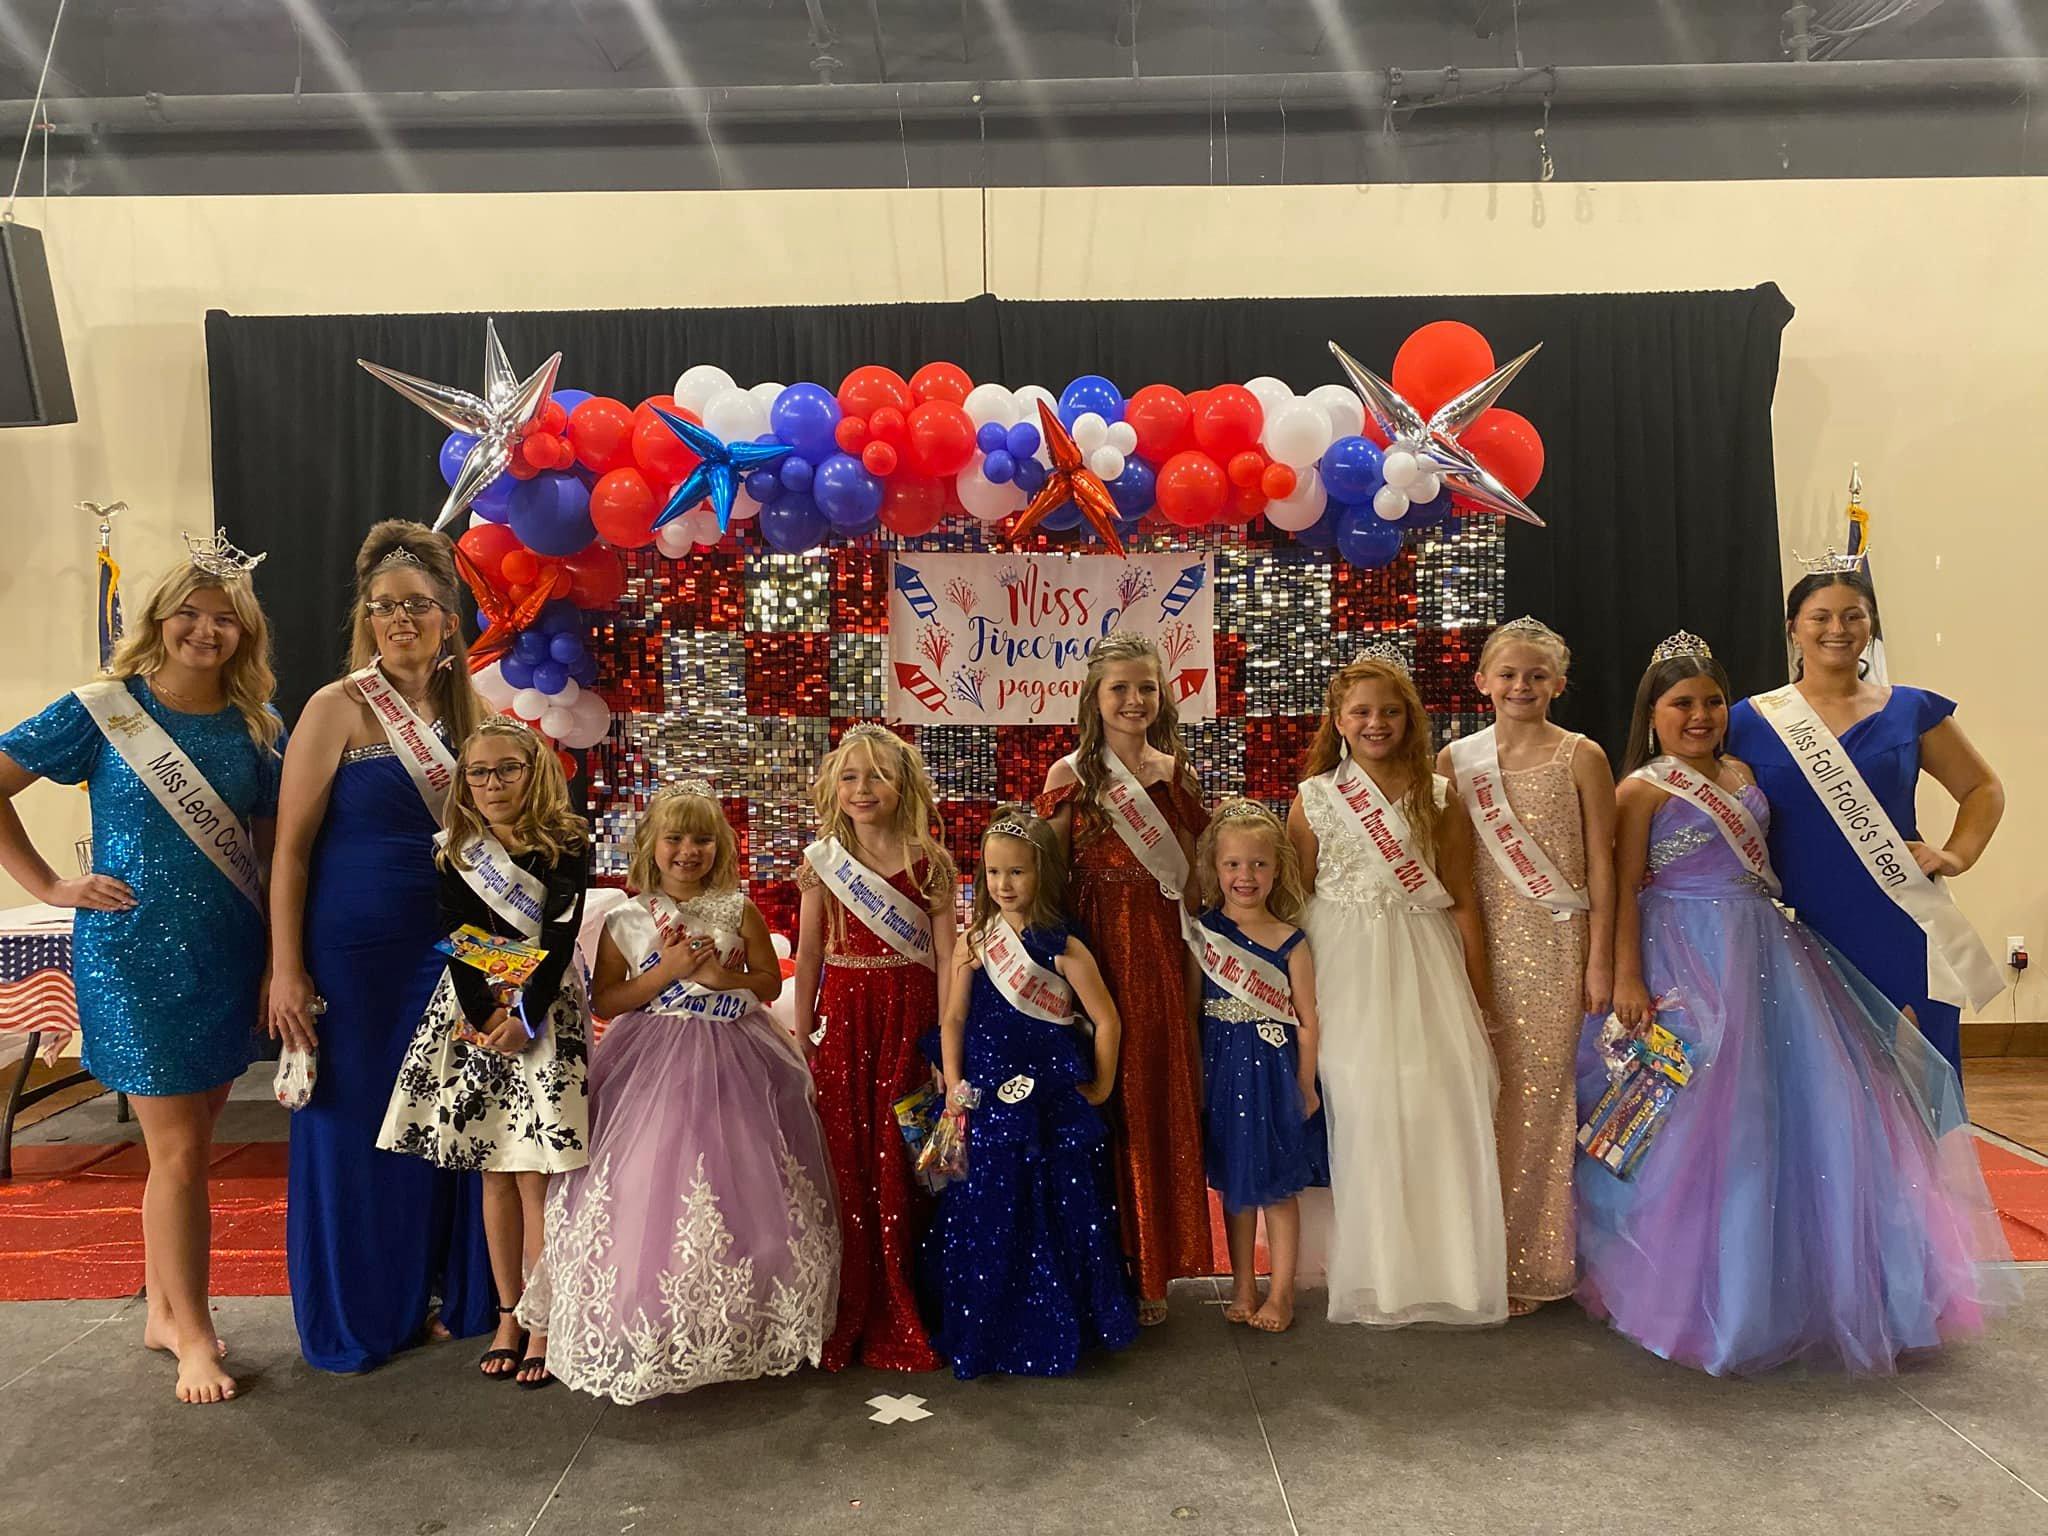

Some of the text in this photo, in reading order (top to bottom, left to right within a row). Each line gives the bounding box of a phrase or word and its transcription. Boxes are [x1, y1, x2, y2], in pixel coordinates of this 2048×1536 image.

[1006, 562, 1097, 627] Miss
[998, 677, 1084, 714] pagean
[372, 691, 407, 724] Amazing
[398, 720, 433, 764] Firecracker
[426, 764, 451, 792] 2024
[147, 752, 187, 793] Miss
[178, 787, 220, 835] Leon
[1664, 769, 1766, 872] Miss Firecracker 2024
[1785, 719, 1908, 888] Miss Fall Frolic's Teen
[1140, 825, 1162, 849] 2024
[1346, 788, 1372, 814] Miss
[1360, 807, 1405, 863] Firecracker
[1393, 859, 1429, 895] 2024
[1219, 956, 1245, 984] Miss
[712, 994, 747, 1019] 2024
[1002, 1080, 1029, 1099] 35
